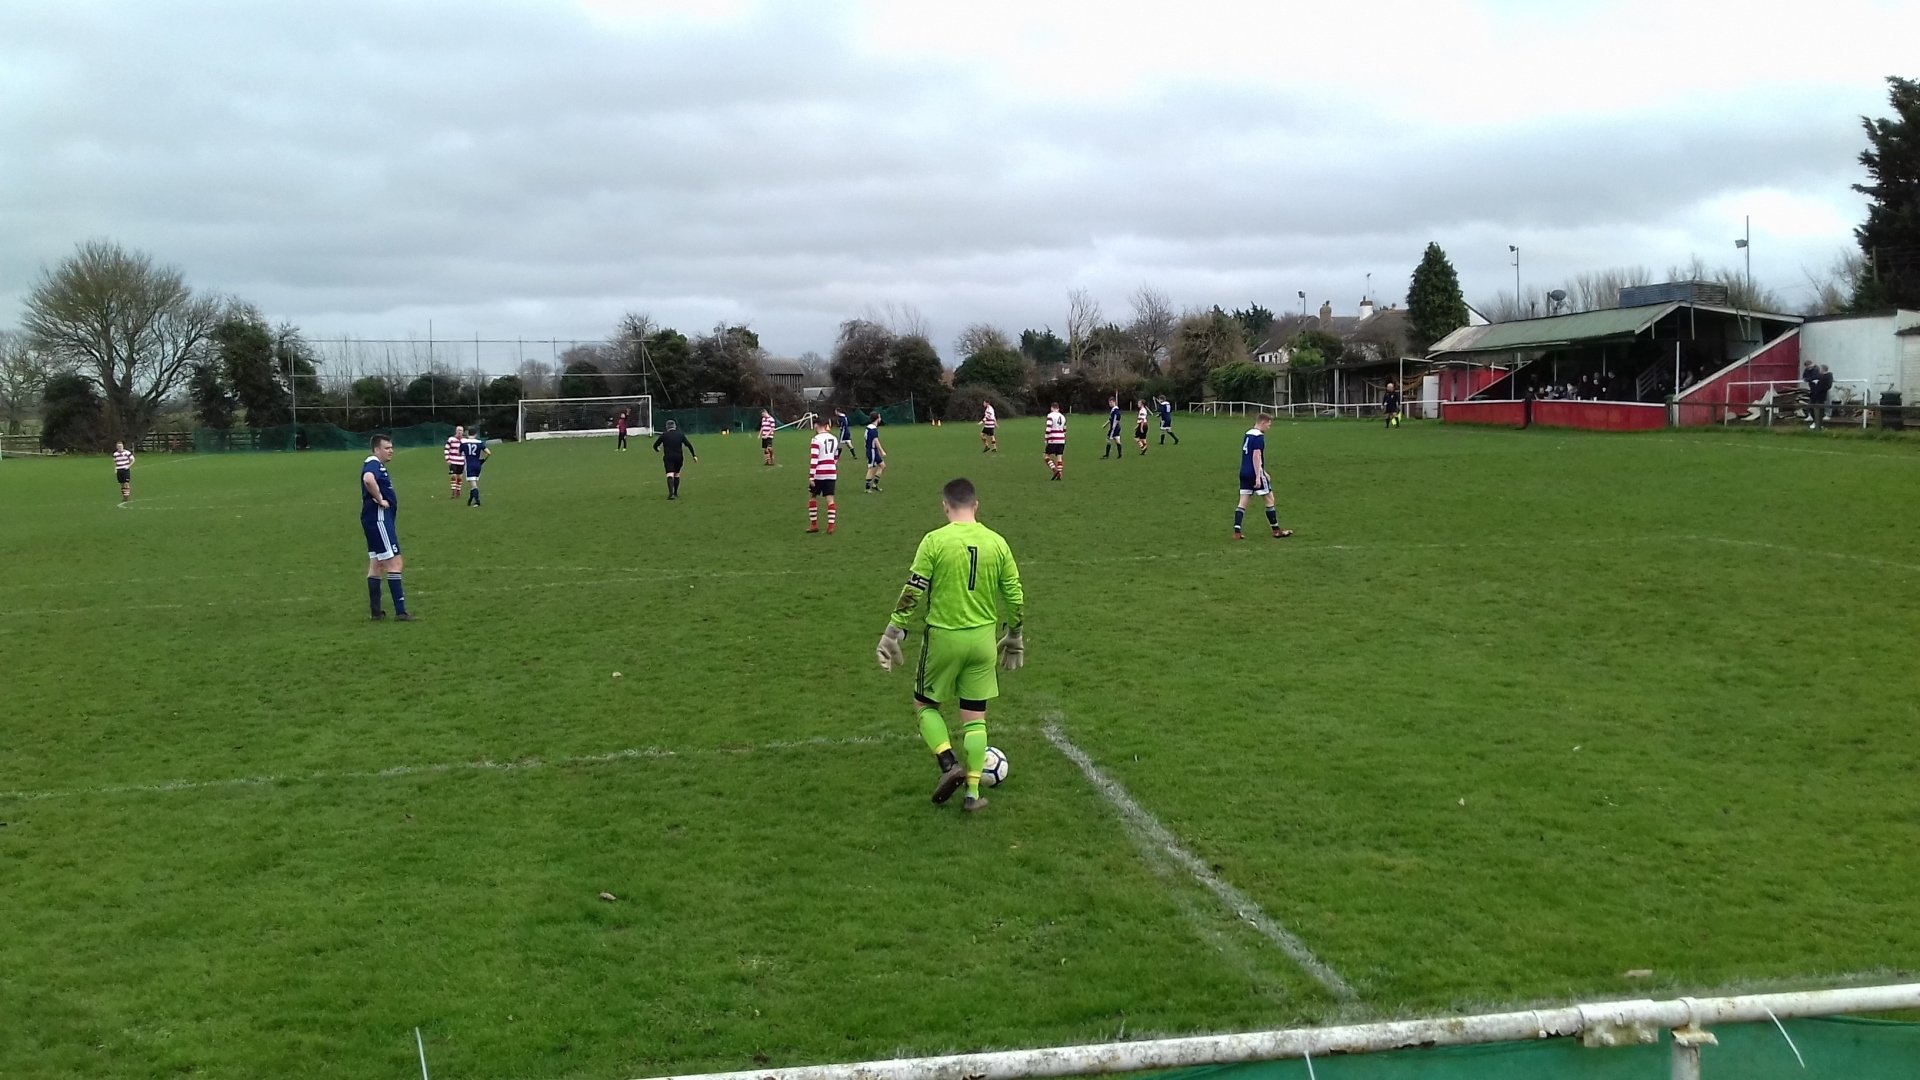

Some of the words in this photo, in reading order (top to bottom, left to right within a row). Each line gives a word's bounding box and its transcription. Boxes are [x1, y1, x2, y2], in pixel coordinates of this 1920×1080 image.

[1057, 415, 1063, 426] 4
[467, 443, 478, 456] 12
[824, 438, 835, 455] 17
[1243, 437, 1249, 455] 4
[392, 544, 399, 553] 5
[967, 546, 978, 591] 1
